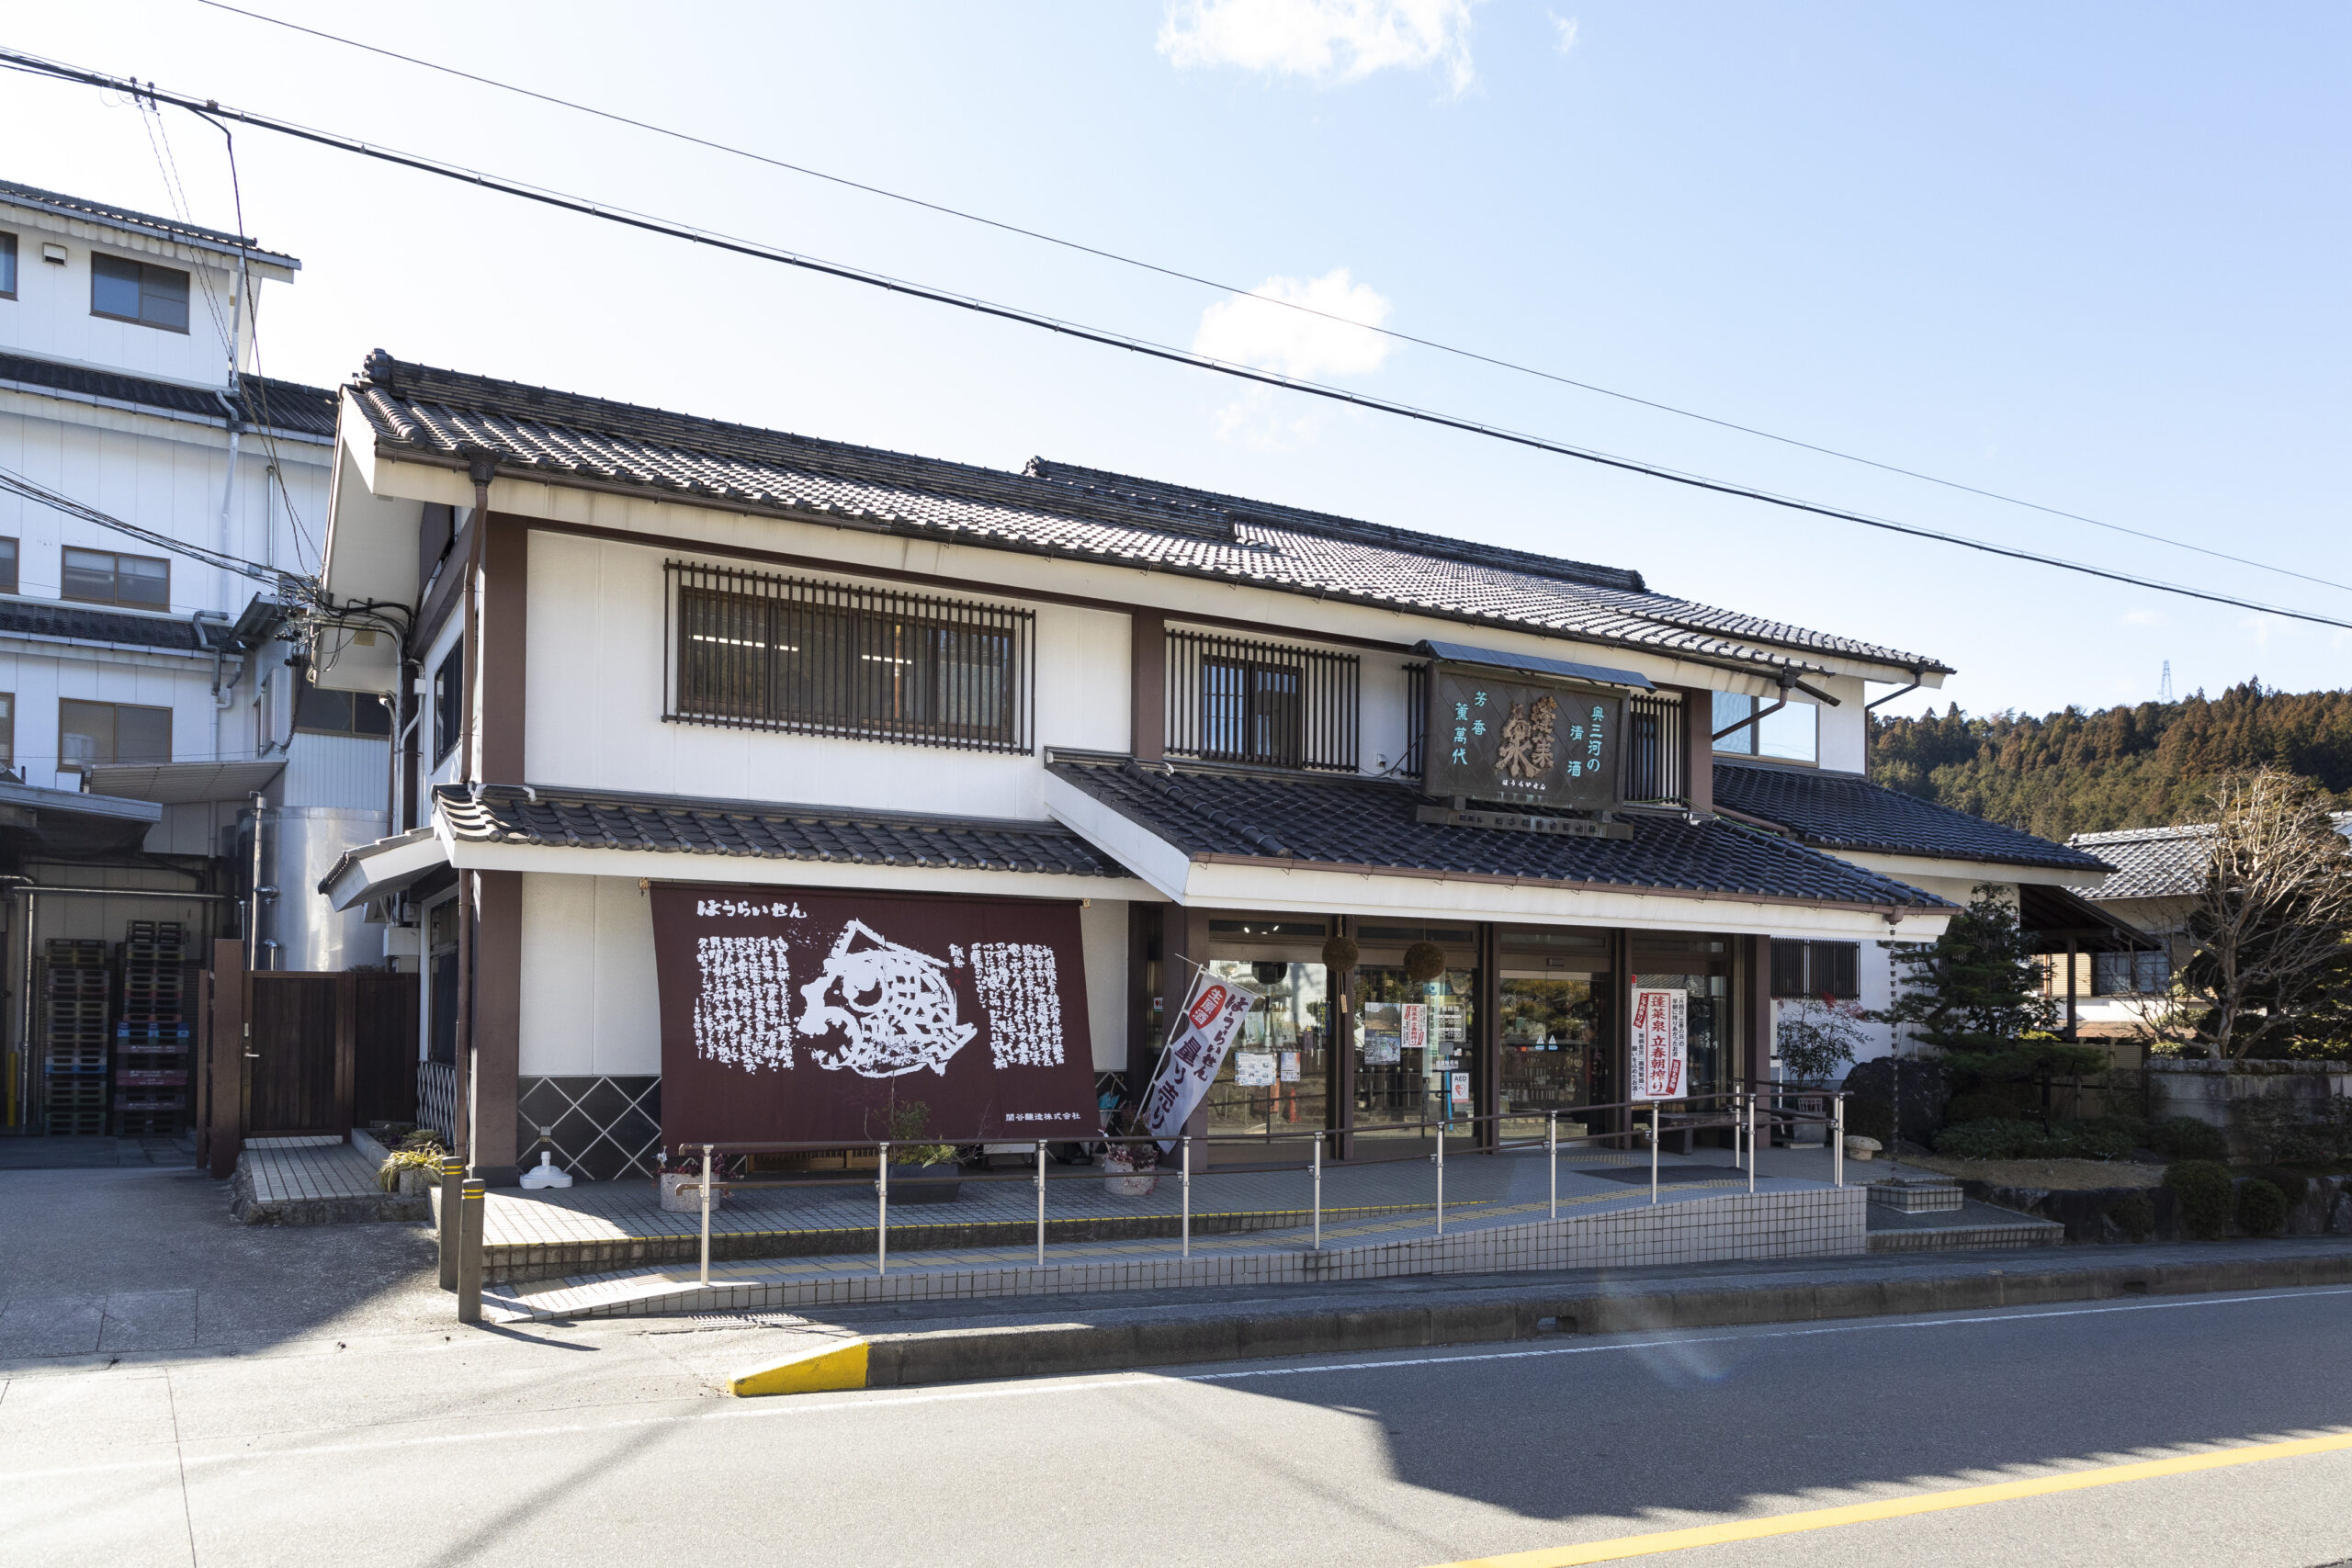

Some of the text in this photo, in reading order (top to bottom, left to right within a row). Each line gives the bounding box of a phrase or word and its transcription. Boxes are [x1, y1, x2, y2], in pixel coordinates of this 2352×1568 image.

[1567, 725, 1584, 777] 清酒
[1587, 705, 1604, 773] 奥三河の
[696, 900, 808, 919] ほうらいせん
[1192, 987, 1224, 1026] 生原酒
[1193, 994, 1249, 1082] ほうらいせん
[1151, 1035, 1203, 1130] 量り売り
